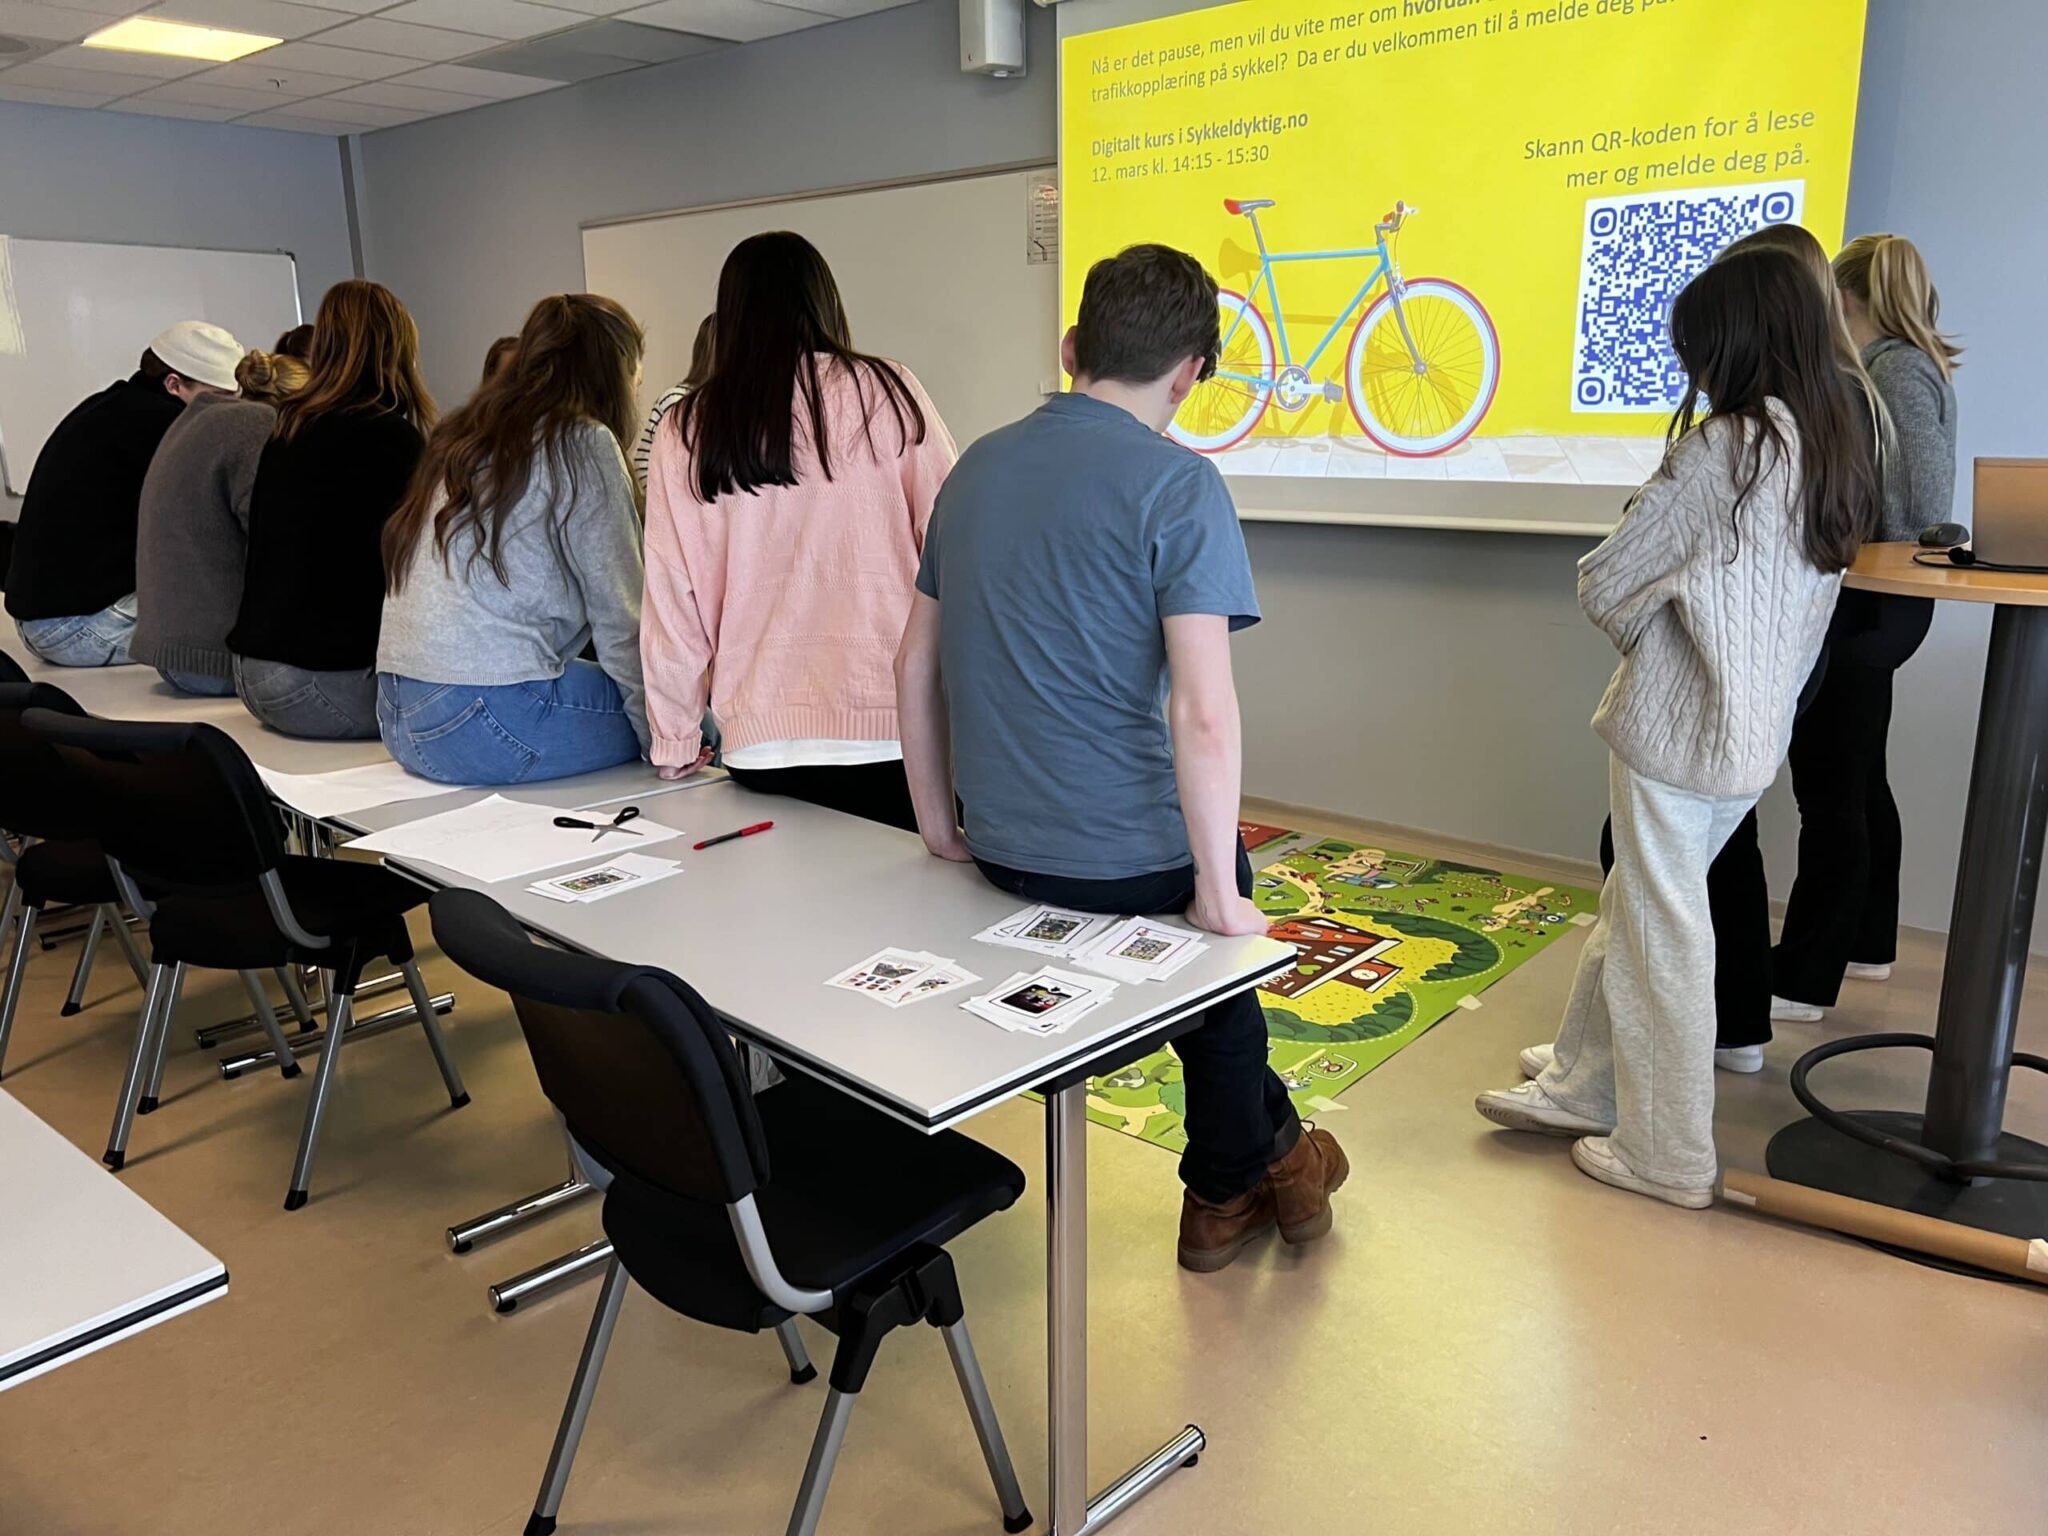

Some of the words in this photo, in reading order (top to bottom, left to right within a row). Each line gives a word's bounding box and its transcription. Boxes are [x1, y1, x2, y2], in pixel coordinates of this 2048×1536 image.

[1091, 56, 1110, 75] Nå
[1114, 57, 1128, 71] er
[1131, 50, 1154, 68] det
[1158, 43, 1205, 67] pause,
[1210, 36, 1243, 54] men
[1248, 27, 1265, 46] vil
[1270, 24, 1290, 42] du
[1295, 18, 1325, 38] vite
[1330, 12, 1365, 31] mer
[1369, 6, 1397, 24] om
[1091, 70, 1205, 102] trafikkopplæring
[1210, 62, 1228, 87] på
[1232, 52, 1288, 81] sykkel?
[1297, 50, 1318, 68] Da
[1323, 47, 1341, 63] er
[1345, 40, 1367, 58] du
[1373, 22, 1478, 54] velkommen
[1484, 13, 1502, 35] til
[1507, 9, 1519, 30] å
[1525, 0, 1589, 28] melde
[1596, 0, 1635, 15] deg
[1091, 134, 1141, 158] Digitalt
[1144, 131, 1175, 149] kurs
[1178, 128, 1183, 144] i
[1186, 113, 1309, 145] Sykkeldyktig.no
[1524, 138, 1584, 160] Skann
[1591, 123, 1696, 152] QR-koden
[1704, 116, 1739, 138] for
[1745, 111, 1759, 134] å
[1767, 110, 1815, 132] lese
[1091, 166, 1111, 183] 12.
[1115, 163, 1149, 180] mars
[1152, 158, 1168, 176] kl.
[1173, 152, 1213, 172] 14:15
[1227, 144, 1269, 166] 15:30
[1567, 168, 1608, 189] mer
[1614, 166, 1638, 186] og
[1645, 153, 1716, 180] melde
[1723, 150, 1768, 173] deg
[1774, 143, 1810, 172] på.
